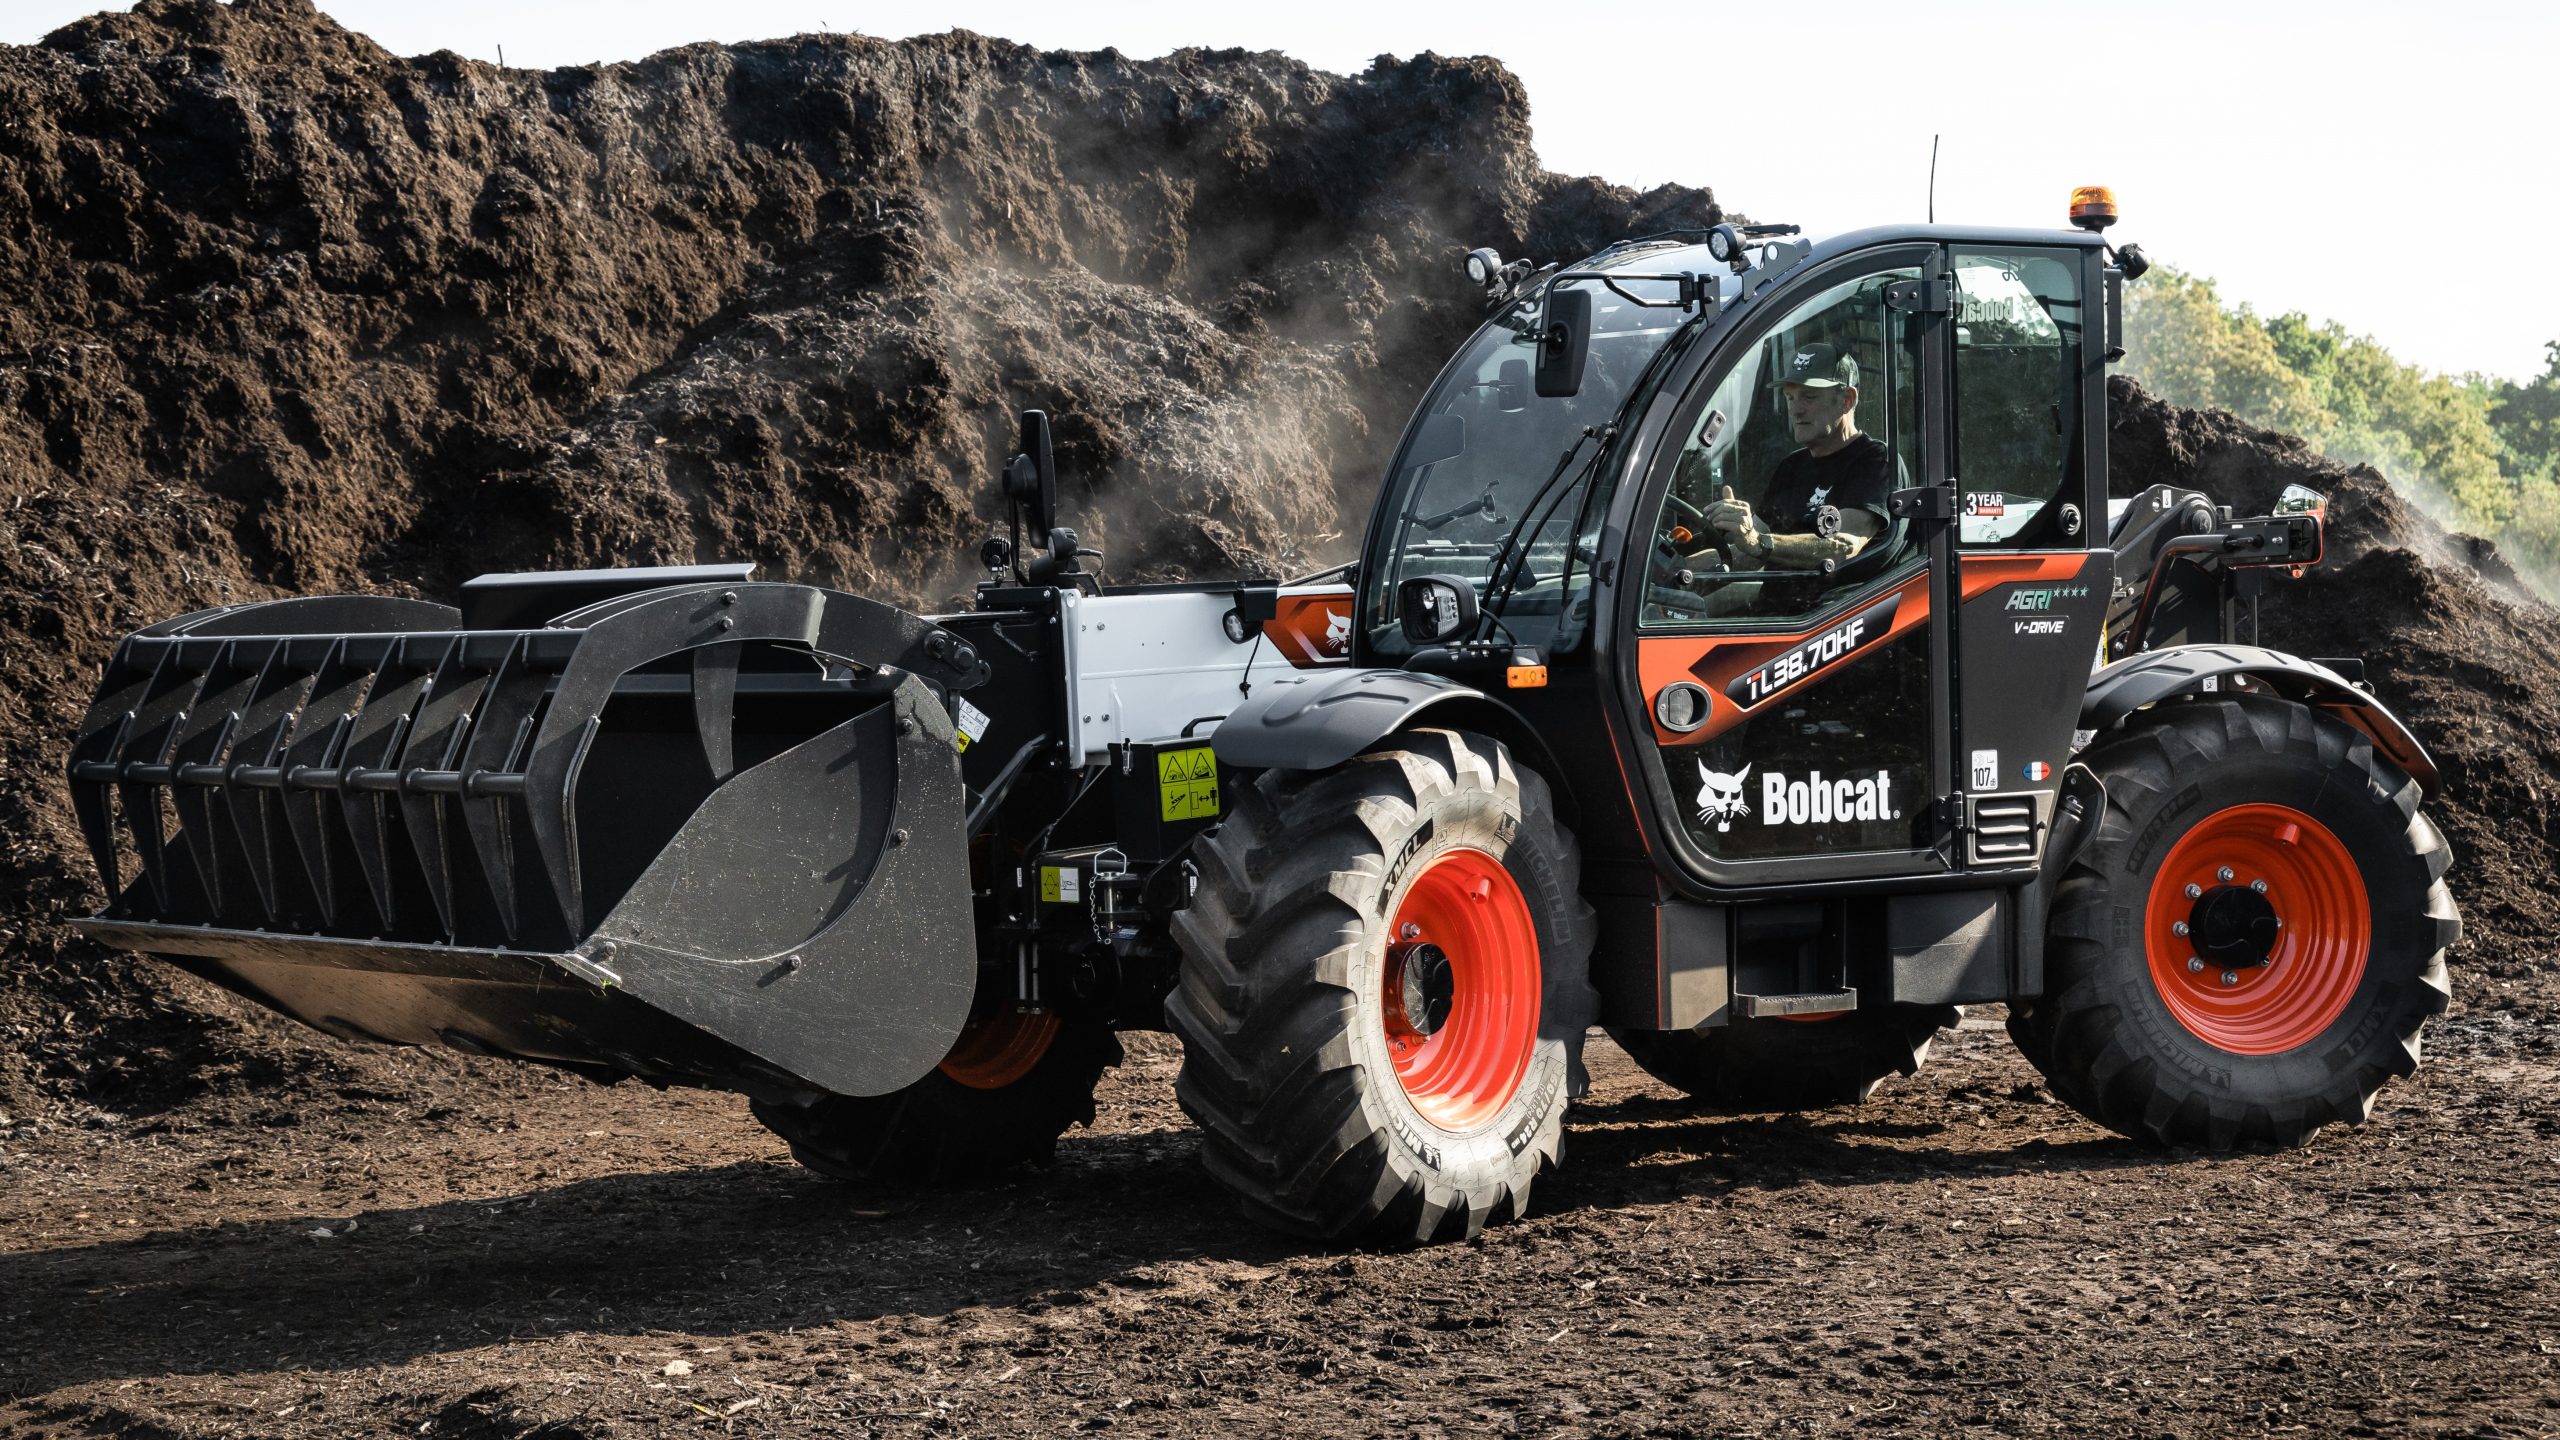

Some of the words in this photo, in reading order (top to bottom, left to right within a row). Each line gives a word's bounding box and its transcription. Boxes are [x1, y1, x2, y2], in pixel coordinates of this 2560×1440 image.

[1966, 493, 1977, 516] 3
[1977, 493, 2003, 507] YEAR
[2004, 590, 2053, 610] AGRI
[2014, 620, 2065, 634] V-DRIVE
[1746, 617, 1864, 701] TL38.70HF
[1762, 769, 1891, 826] Bobcat
[1973, 767, 1991, 787] 107
[1384, 833, 1422, 900] XMCL
[2124, 983, 2205, 1076] MICHELIN
[2339, 1001, 2391, 1056] XMCL
